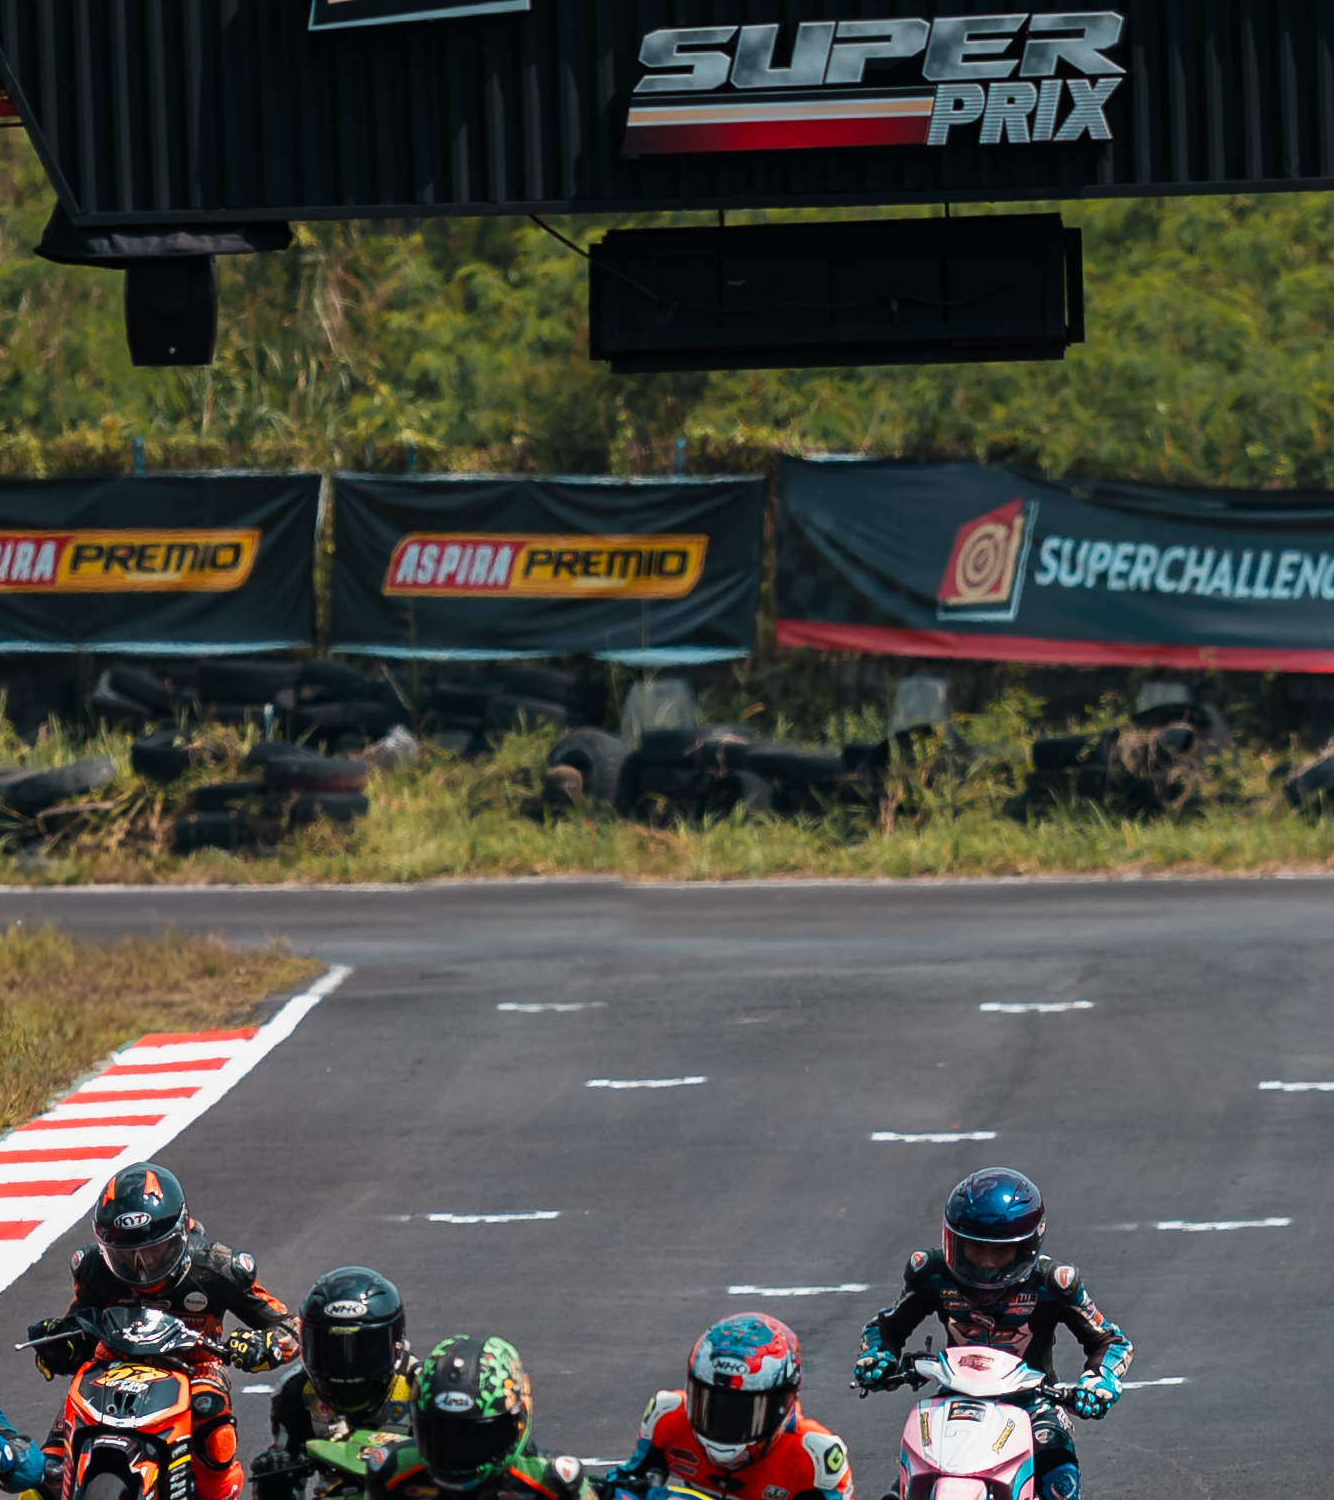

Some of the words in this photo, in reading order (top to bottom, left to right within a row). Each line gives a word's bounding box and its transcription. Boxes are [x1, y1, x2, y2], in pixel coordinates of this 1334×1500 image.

[632, 11, 1128, 93] SUPER
[925, 78, 1123, 146] PRIX
[69, 542, 242, 574] PREMIO
[395, 543, 518, 587] ASPIRA
[523, 547, 690, 579] PREMIO
